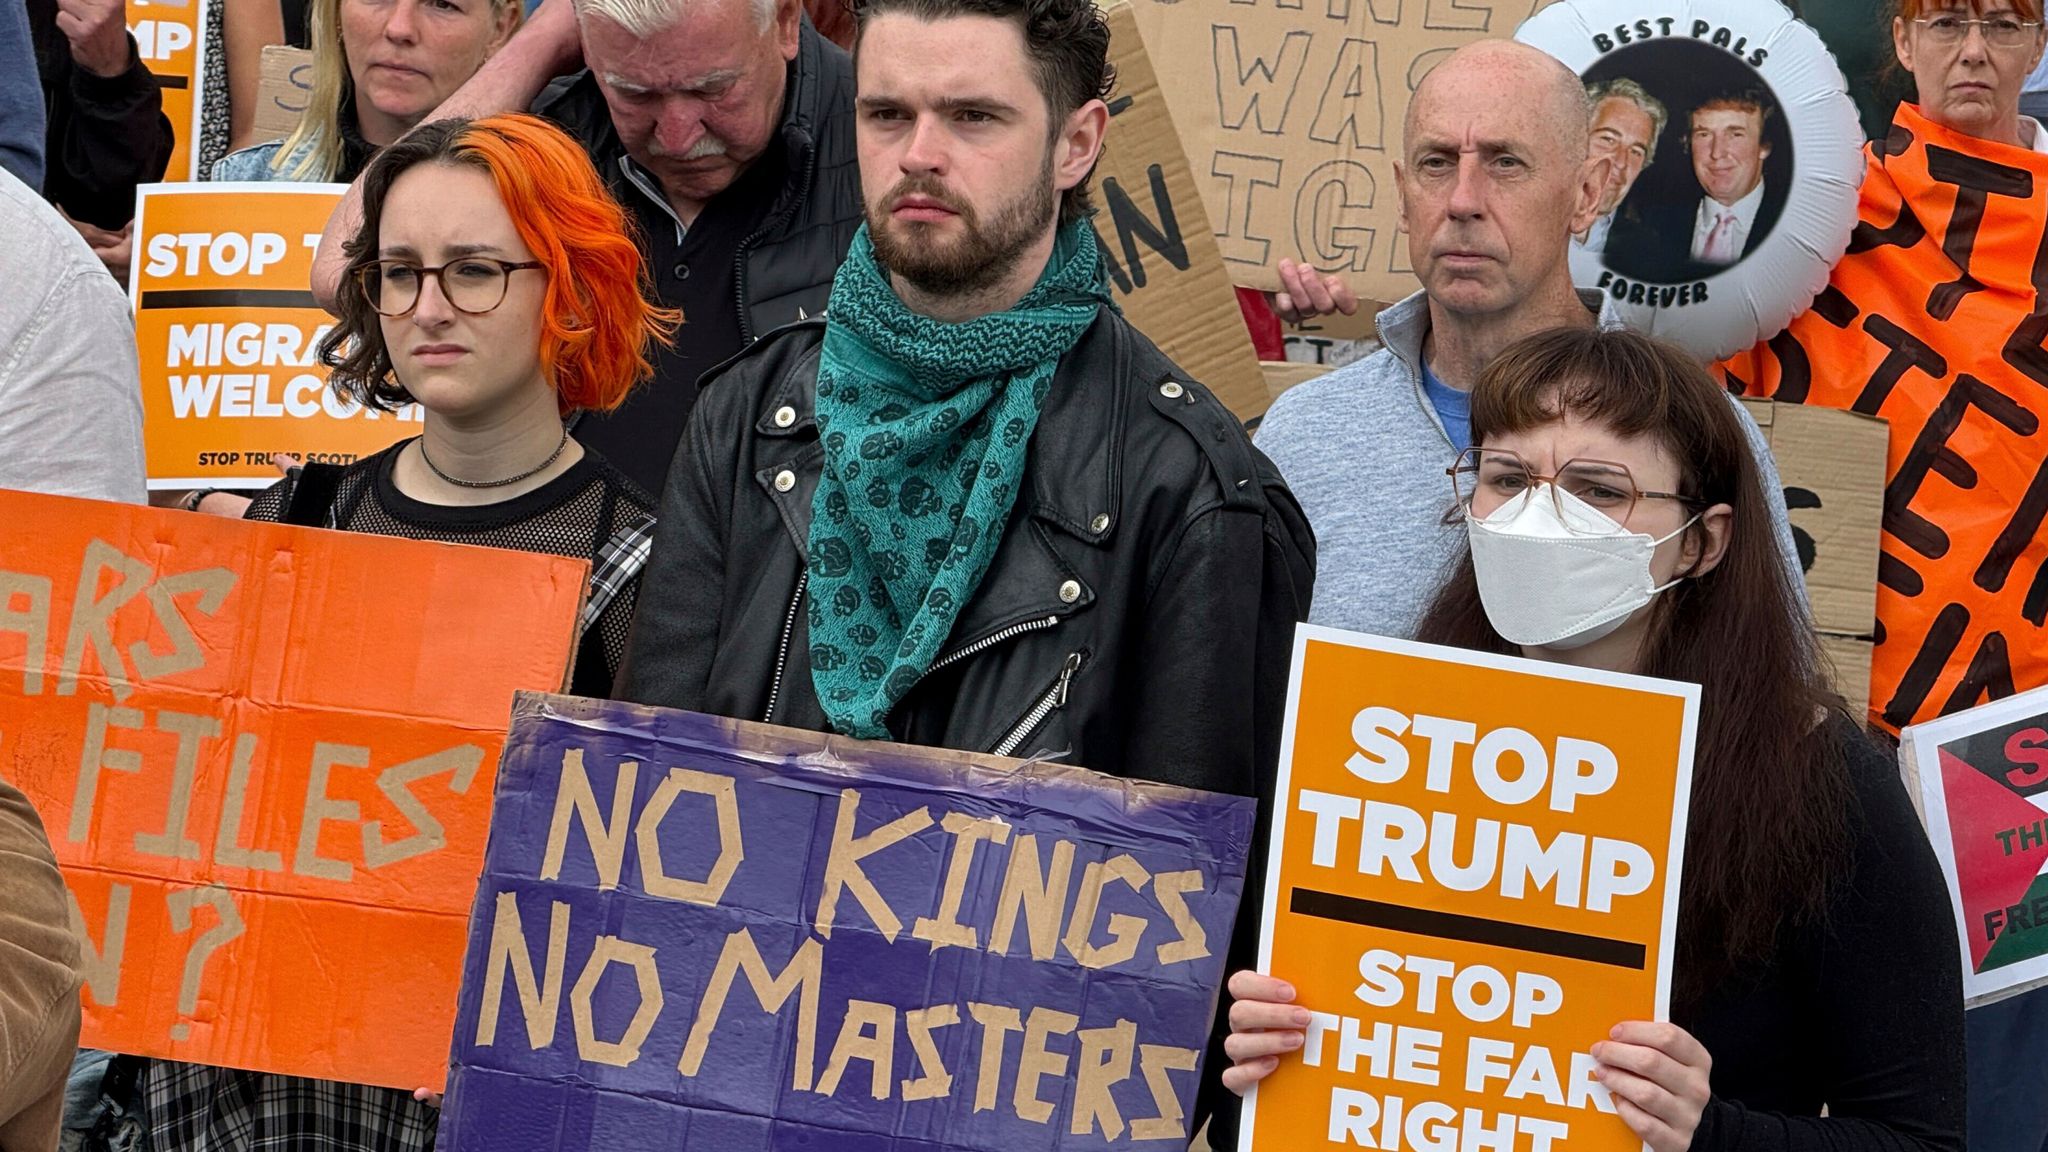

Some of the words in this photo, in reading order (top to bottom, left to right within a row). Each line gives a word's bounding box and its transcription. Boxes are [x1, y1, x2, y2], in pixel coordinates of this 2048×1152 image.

[1592, 17, 1674, 53] BEST
[1692, 19, 1768, 67] PALS
[145, 231, 287, 278] STOP
[1598, 270, 1709, 309] FOREVER
[167, 322, 336, 368] MIGRA
[198, 452, 240, 466] STOP
[244, 452, 301, 466] TRUP
[68, 701, 486, 883] FILES
[1343, 706, 1619, 813] STOP
[539, 747, 745, 907] NO
[815, 788, 1212, 969] KINGS
[1298, 788, 1655, 913] TRUMP
[1995, 818, 2048, 857] TH
[475, 892, 665, 1068] NO
[678, 923, 1201, 1143] MASTERS
[1354, 949, 1563, 1028] STOP
[1302, 1010, 1443, 1086] THE
[1465, 1036, 1619, 1115] FAR
[1327, 1086, 1569, 1152] RIGHT
